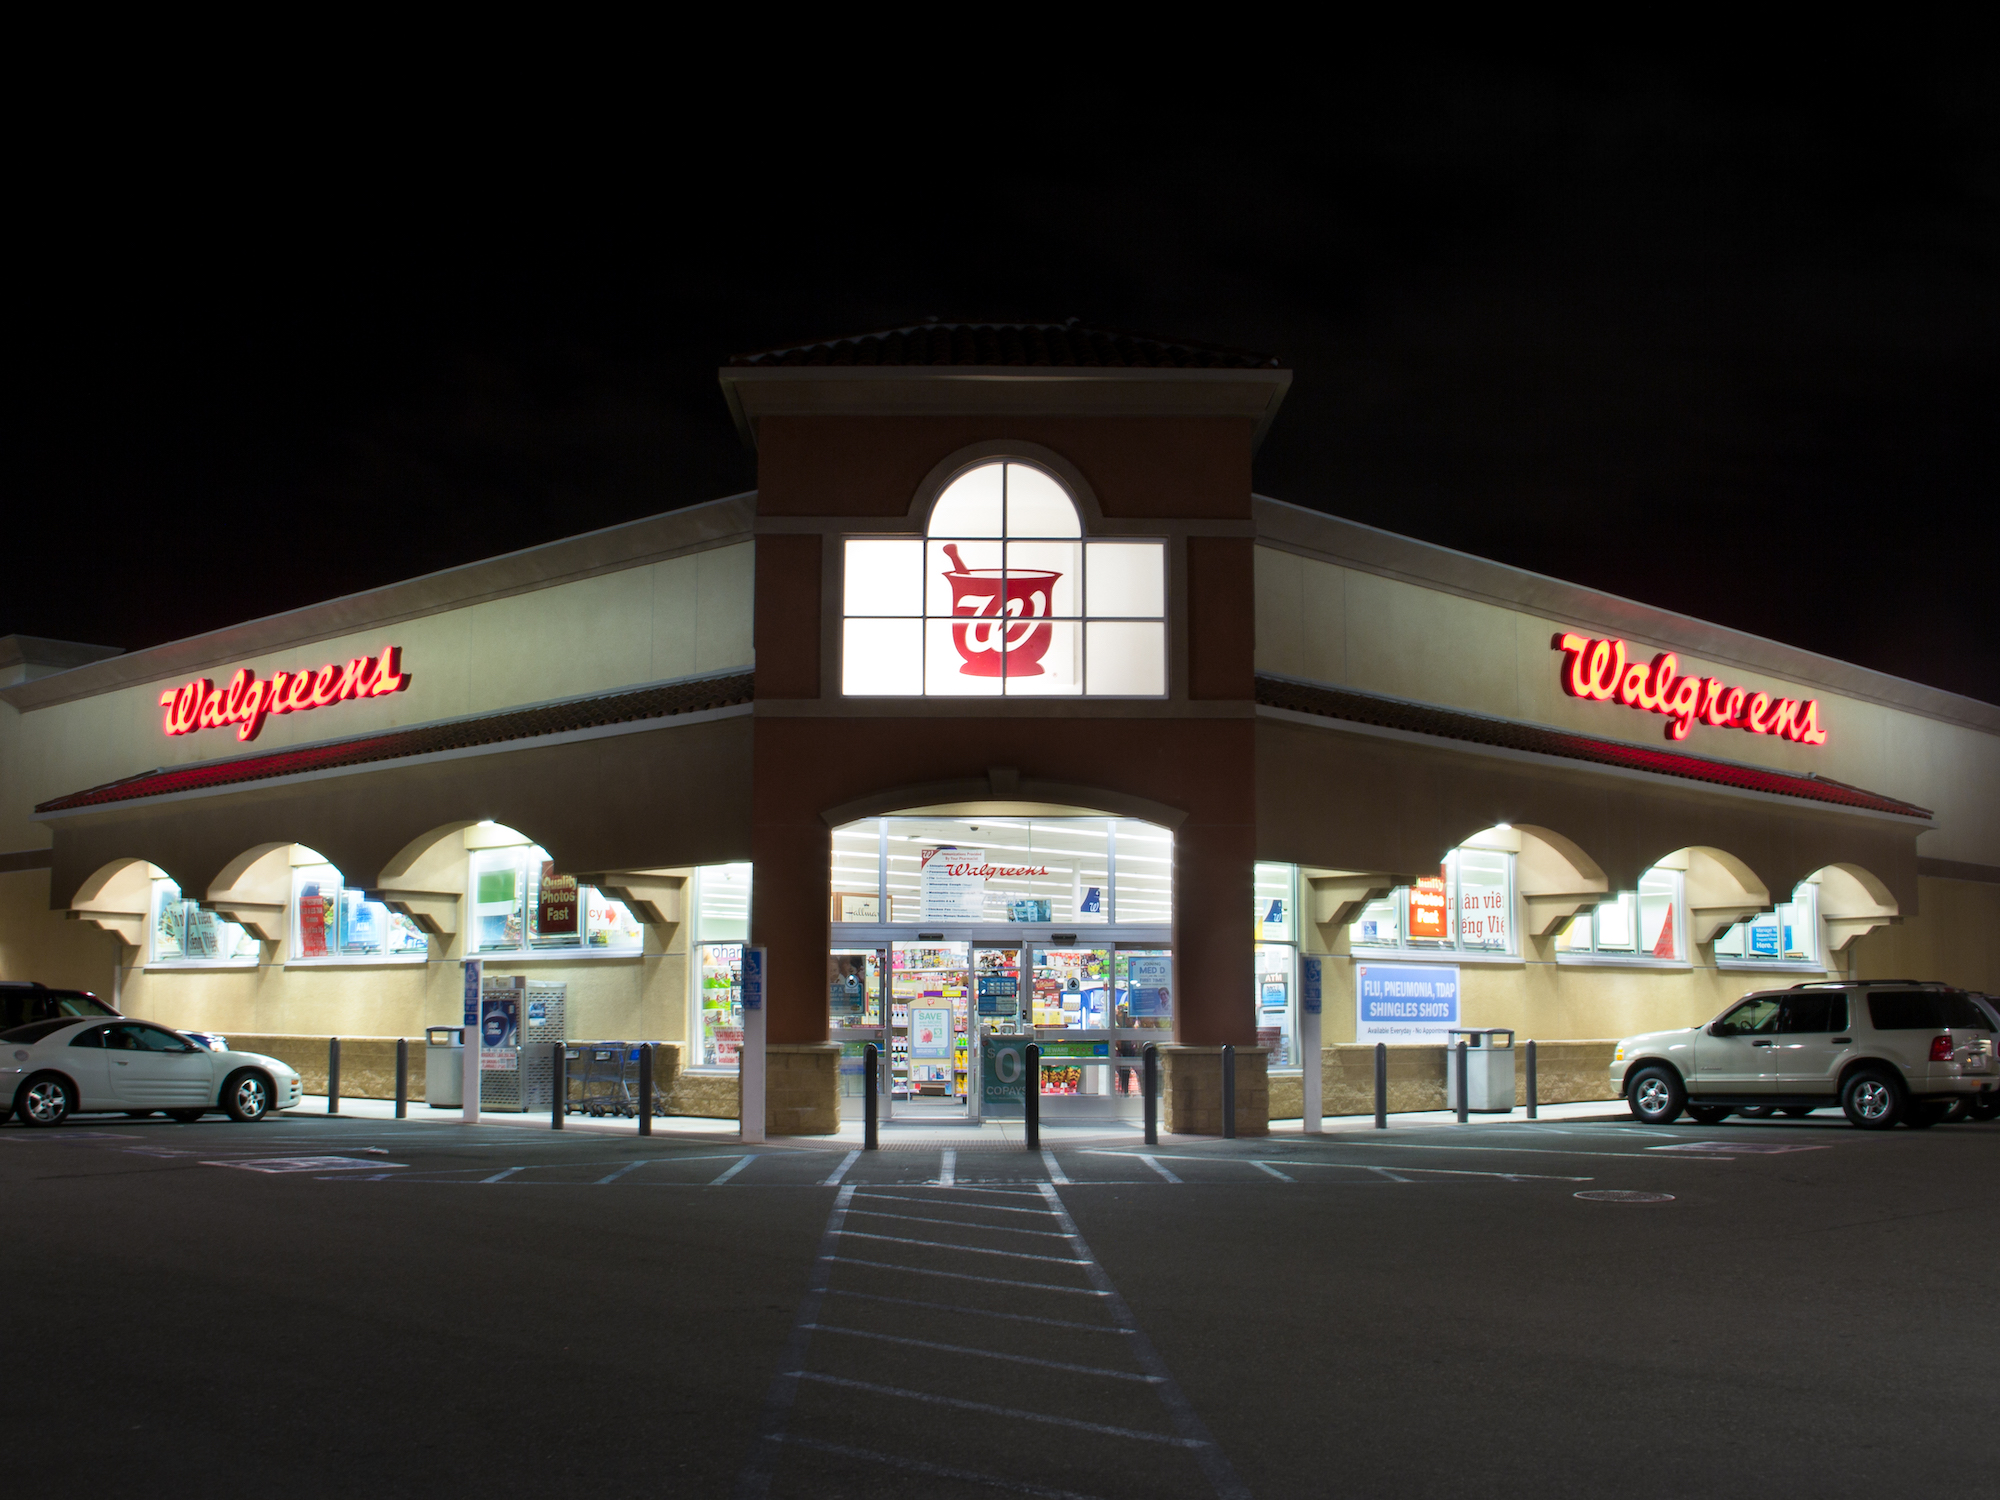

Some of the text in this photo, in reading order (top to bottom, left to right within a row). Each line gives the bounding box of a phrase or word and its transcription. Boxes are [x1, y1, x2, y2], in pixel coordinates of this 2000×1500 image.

[159, 646, 406, 741] Walgreens
[1557, 632, 1827, 744] Walgreens
[945, 862, 1050, 881] Walgreens
[542, 874, 577, 890] Quality
[1416, 876, 1443, 892] uality
[541, 890, 576, 904] Photos
[1448, 891, 1505, 911] nân viê
[547, 907, 569, 921] Fast
[356, 923, 370, 931] ATM
[1139, 966, 1166, 974] MED D
[1265, 973, 1283, 982] ATM
[1364, 980, 1456, 1000] FLU, PNEUMONIA, TDAP
[918, 1012, 943, 1021] SAVE
[1370, 1002, 1449, 1017] SHINGLES SHOTS
[1390, 1027, 1412, 1036] Everyday
